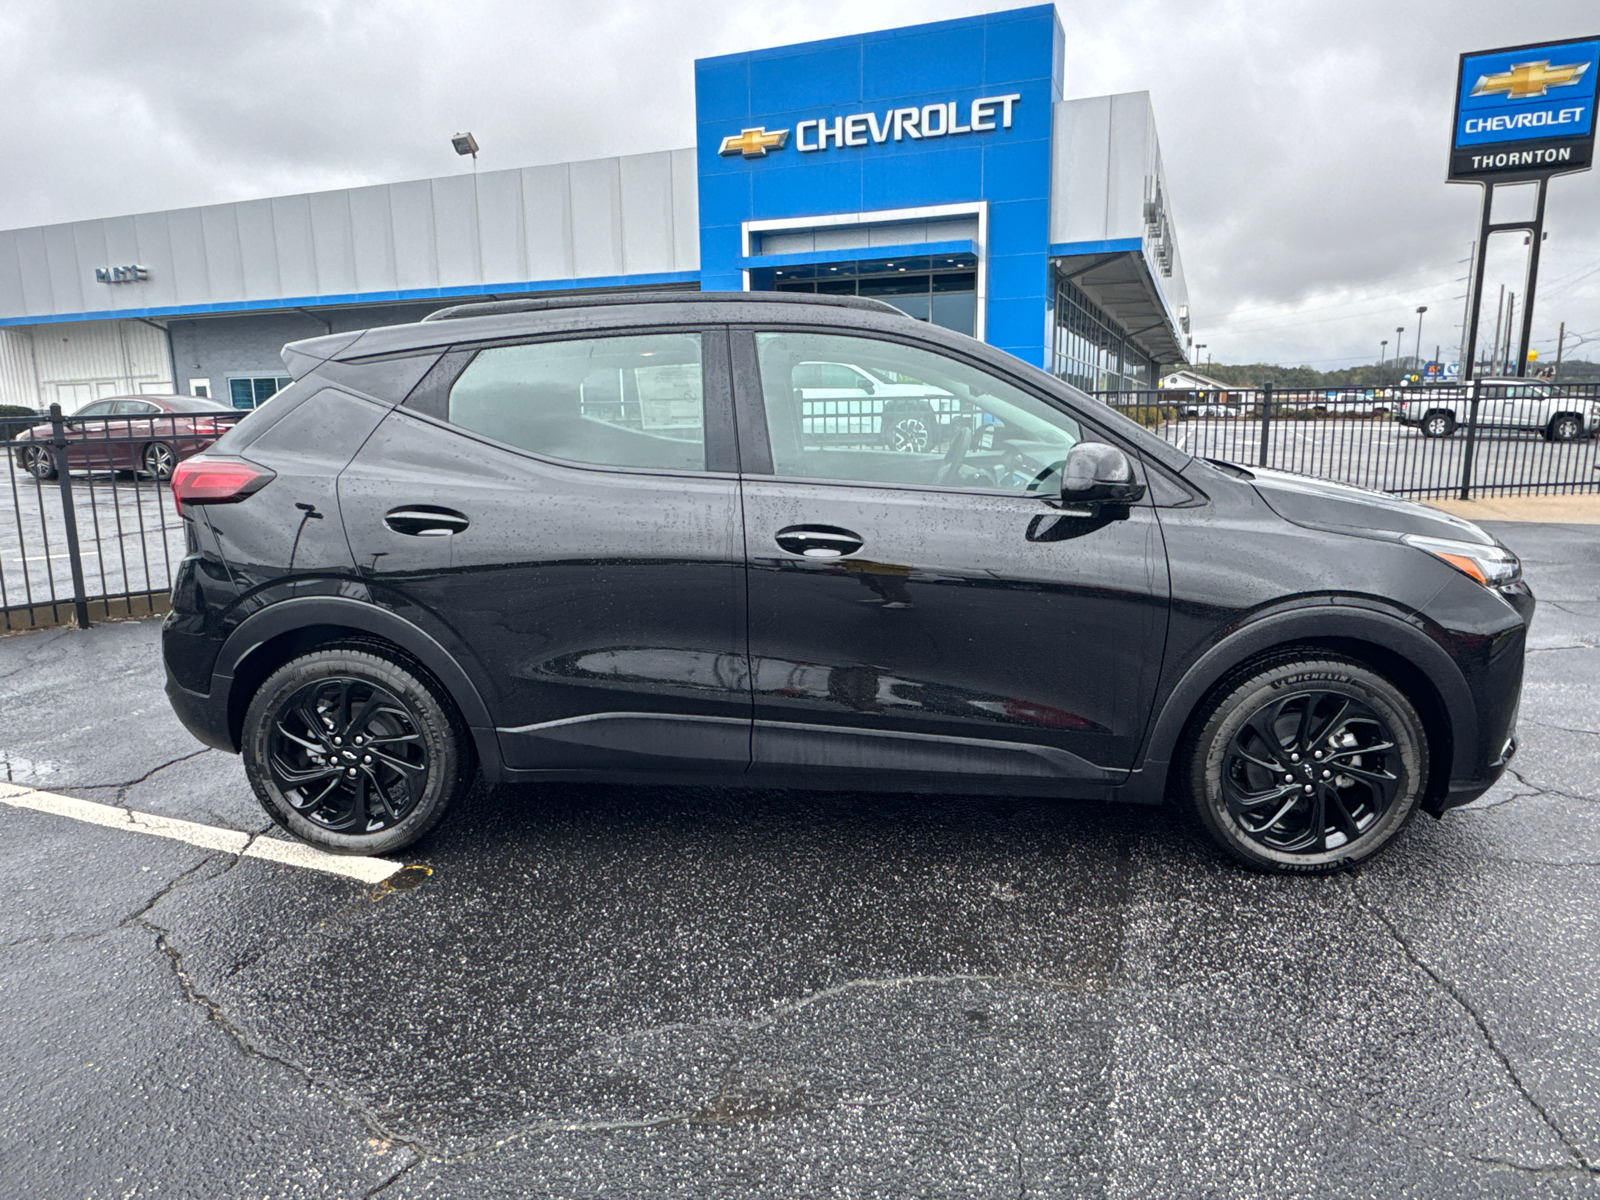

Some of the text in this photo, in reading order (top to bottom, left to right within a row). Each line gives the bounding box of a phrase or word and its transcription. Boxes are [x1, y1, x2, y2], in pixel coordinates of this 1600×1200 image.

[796, 93, 1021, 152] CHEVROLET
[1465, 107, 1585, 134] CHEVROLET
[1472, 147, 1571, 169] THORNTON
[95, 264, 142, 283] PARTS
[1287, 673, 1348, 684] MICHELIN
